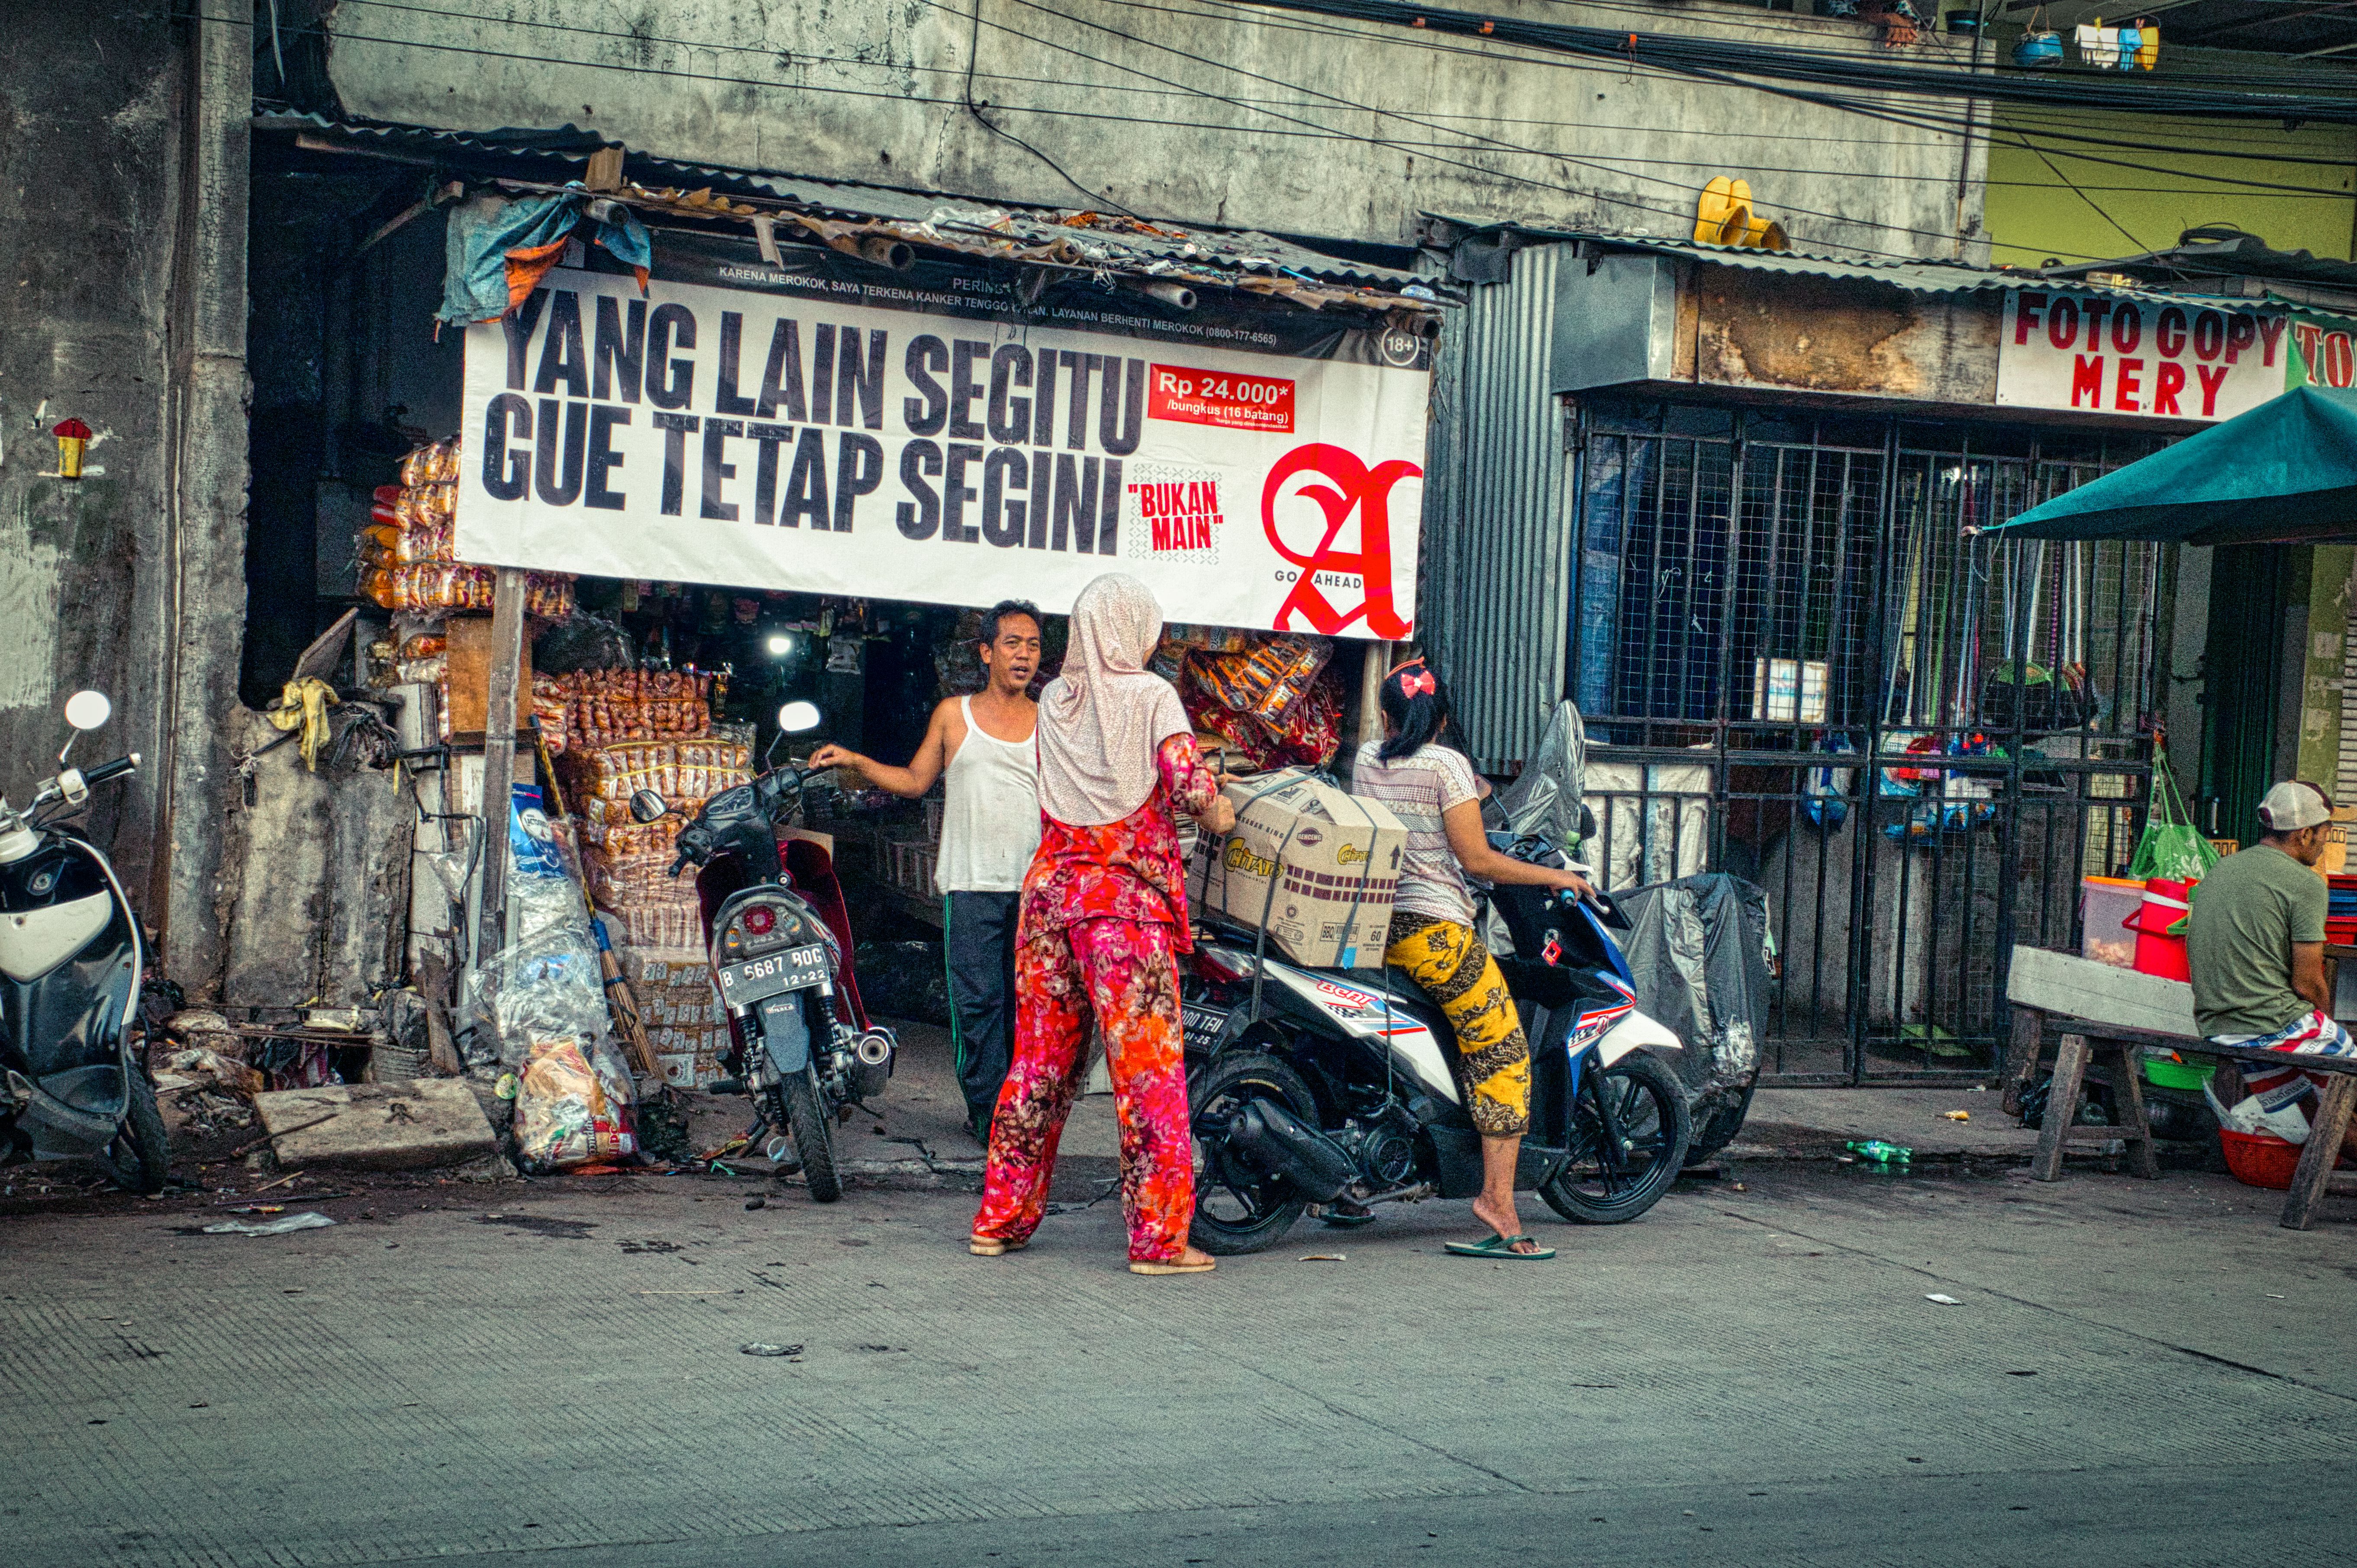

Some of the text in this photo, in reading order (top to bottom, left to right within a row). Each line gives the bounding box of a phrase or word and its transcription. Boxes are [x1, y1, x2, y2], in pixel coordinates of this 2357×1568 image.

[719, 267, 767, 282] KARENA
[769, 274, 829, 292] MEROKOK,
[832, 280, 860, 294] SAYA
[862, 284, 914, 301] TERKENA
[916, 293, 961, 306] KANKER
[1052, 308, 1098, 322] LAYANAN
[1101, 313, 1151, 328] BERHENTI
[1153, 320, 1204, 336] MEROKOK
[1206, 326, 1277, 346] (0800-177-6565)
[1386, 337, 1413, 352] 18+
[2015, 291, 2288, 367] FOTO COPY
[502, 288, 1145, 456] YANG LAIN SEGITU
[1159, 372, 1193, 399] Rp
[2071, 354, 2230, 416] MERY
[1167, 399, 1289, 424] /bungkus (16 batang)
[1244, 421, 1289, 429] direkomendasikan
[482, 393, 1123, 556] GUE TETAP SEGINI
[1128, 481, 1218, 518] "BUKAN
[1151, 515, 1223, 551] MAIN"
[1275, 570, 1362, 589] GO AHEAD
[1322, 925, 1335, 939] BBQ
[1370, 930, 1381, 942] 60
[722, 948, 822, 987] B 5687 BOG
